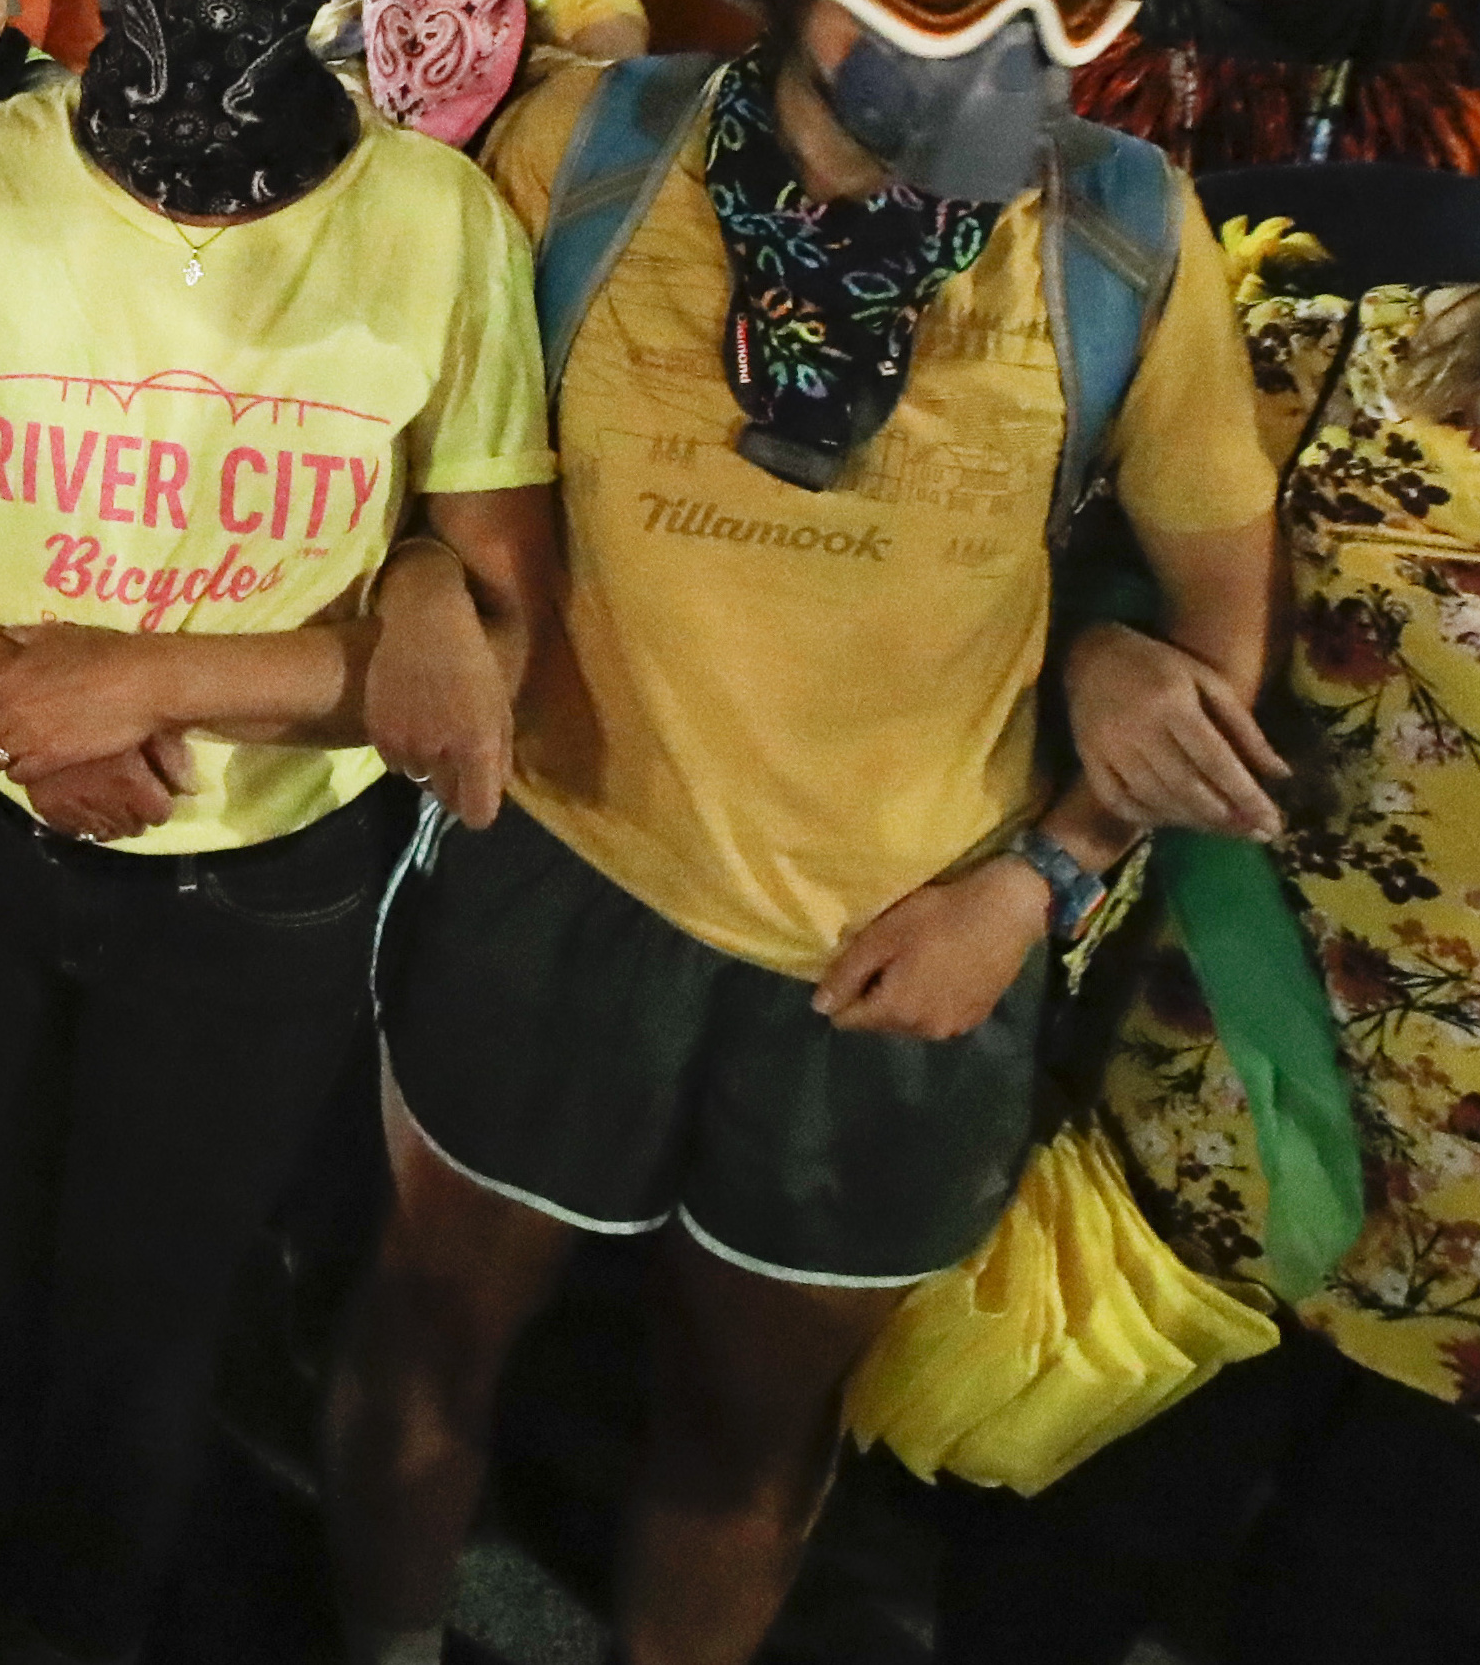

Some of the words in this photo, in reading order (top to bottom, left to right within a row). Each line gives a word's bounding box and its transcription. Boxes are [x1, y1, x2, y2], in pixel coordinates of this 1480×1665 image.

[219, 446, 379, 541] CITY
[639, 492, 893, 563] Tillamook
[43, 533, 285, 634] Bicycles
